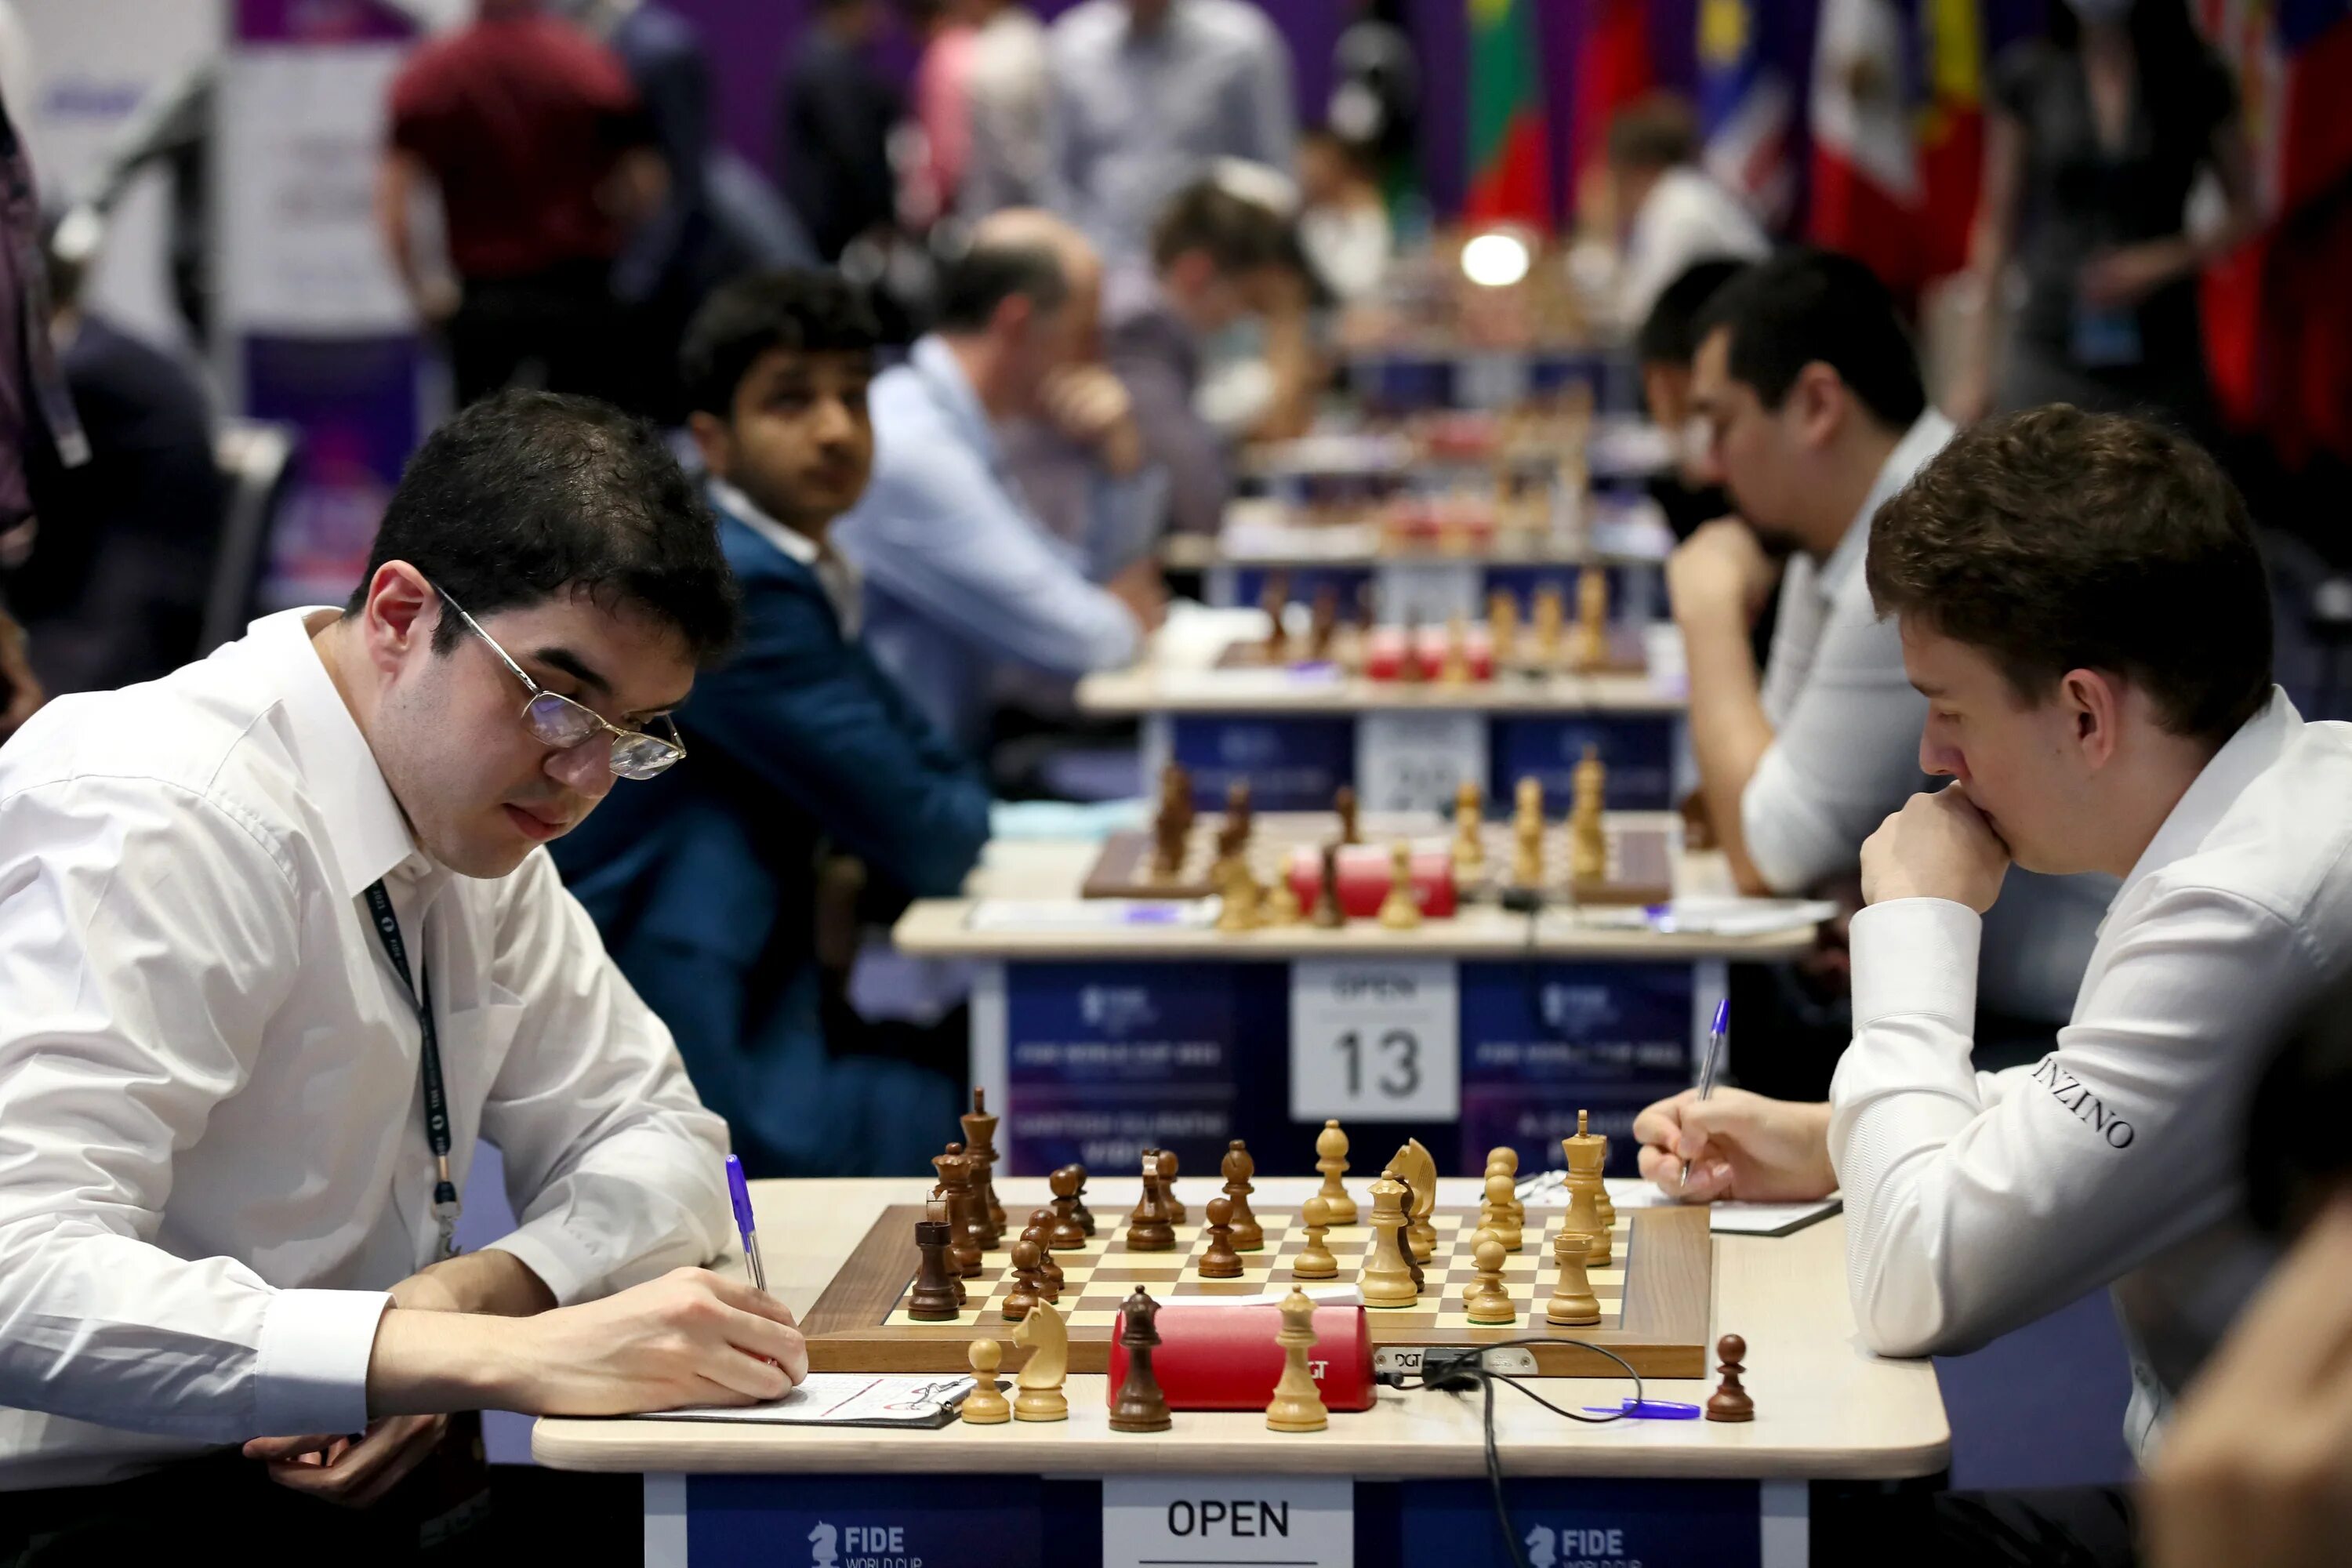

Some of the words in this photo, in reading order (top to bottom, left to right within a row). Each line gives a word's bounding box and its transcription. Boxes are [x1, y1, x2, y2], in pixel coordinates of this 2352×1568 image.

[1333, 973, 1416, 1001] OPEN
[1335, 1030, 1421, 1099] 13
[2031, 1056, 2135, 1149] INZINO
[1307, 1360, 1329, 1380] GT
[1395, 1353, 1421, 1367] DGT
[1167, 1499, 1289, 1537] OPEN
[844, 1526, 904, 1553] FIDE
[1563, 1529, 1624, 1556] FIDE
